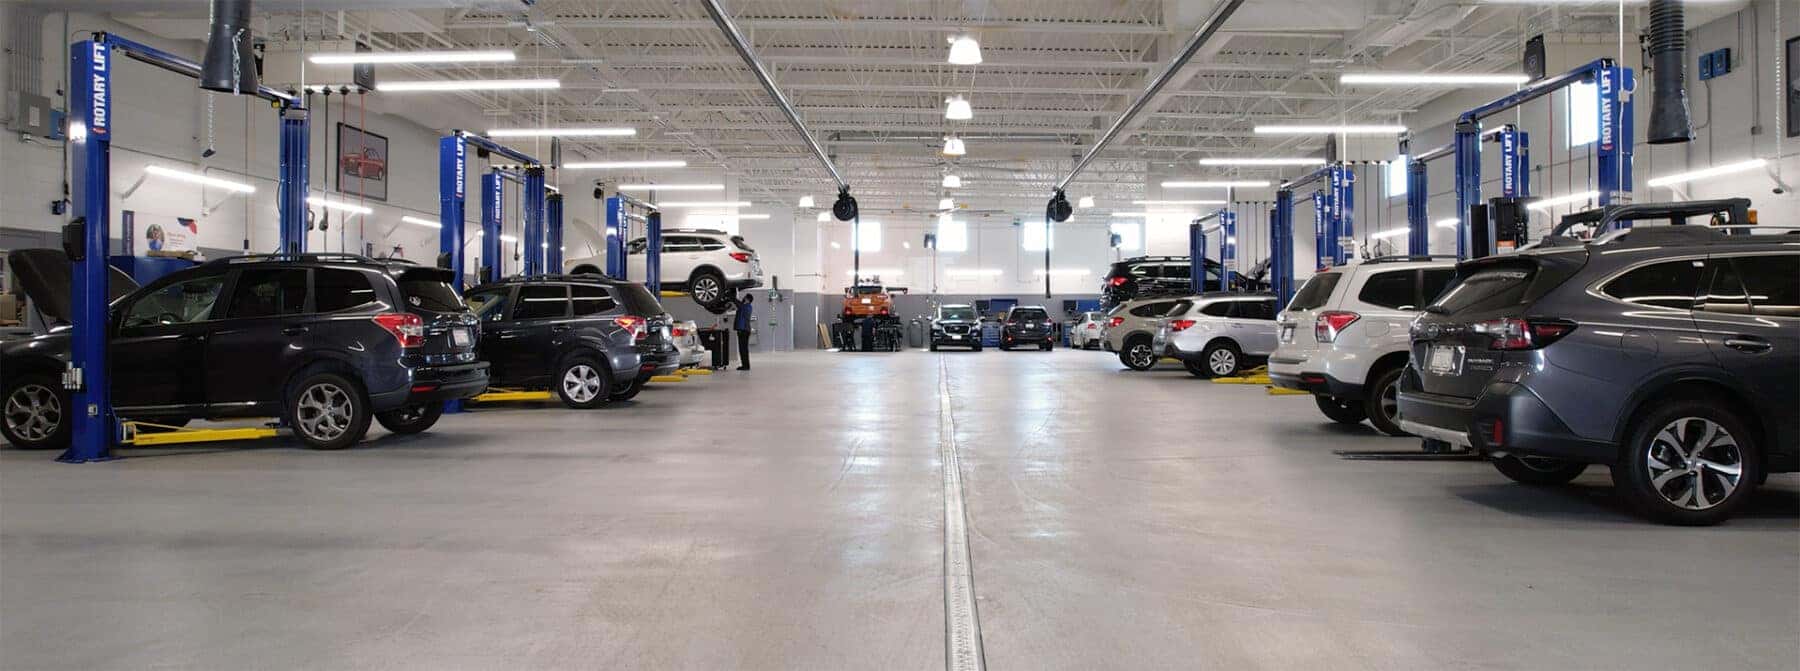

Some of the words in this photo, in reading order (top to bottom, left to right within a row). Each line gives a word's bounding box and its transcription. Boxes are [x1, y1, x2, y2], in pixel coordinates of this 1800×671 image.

[93, 42, 105, 72] LIFT
[1601, 69, 1612, 94] LIFT
[93, 73, 105, 127] ROTARY
[1602, 98, 1612, 145] ROTARY
[456, 137, 464, 157] LIFT
[1504, 133, 1513, 153] LIFT
[456, 158, 464, 193] ROTARY
[1505, 154, 1513, 190] ROTARY
